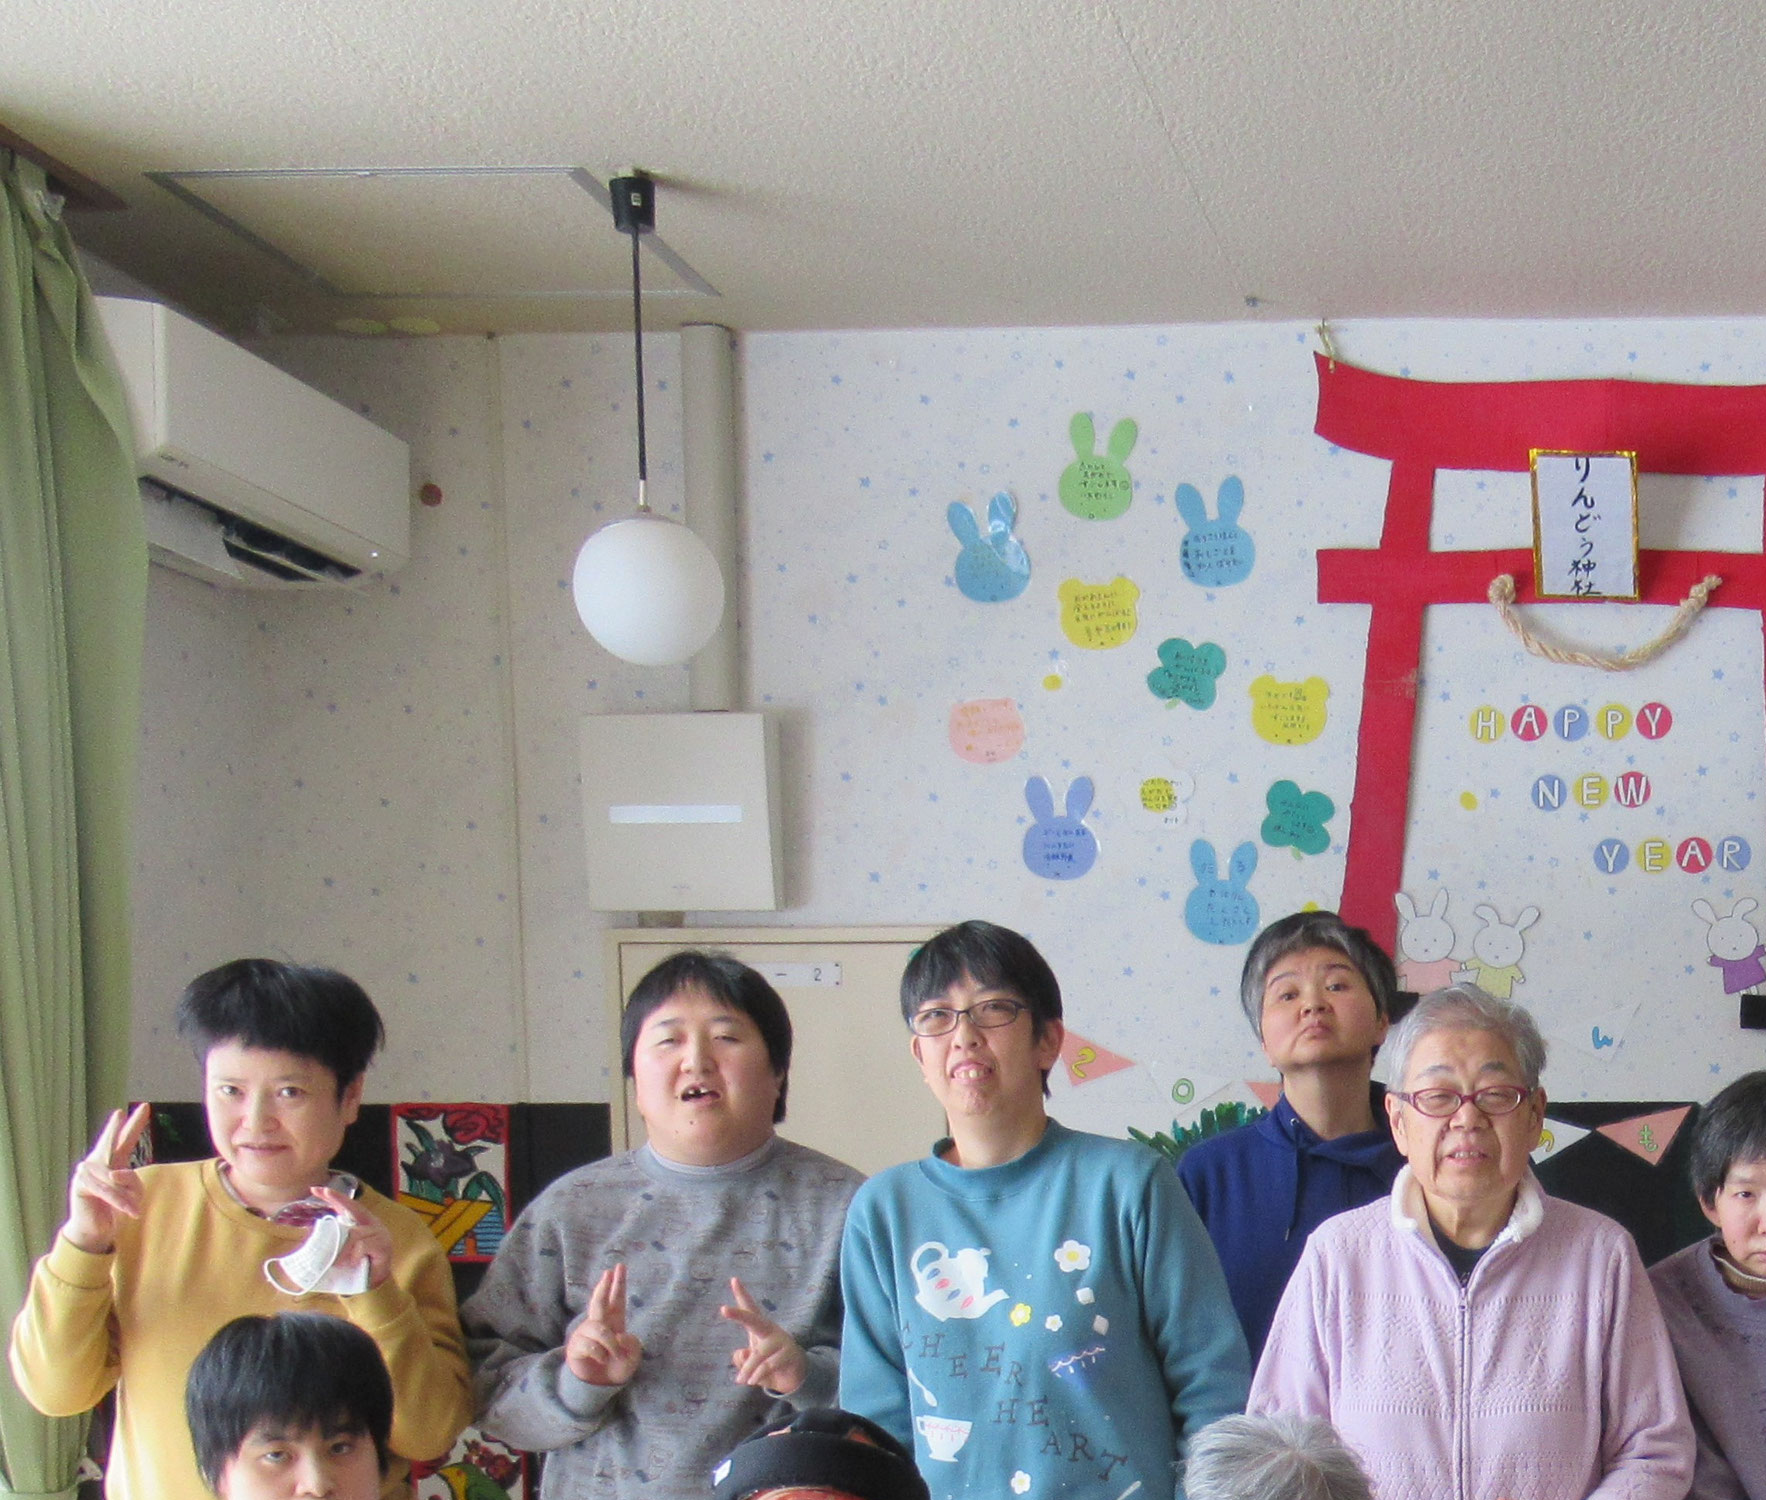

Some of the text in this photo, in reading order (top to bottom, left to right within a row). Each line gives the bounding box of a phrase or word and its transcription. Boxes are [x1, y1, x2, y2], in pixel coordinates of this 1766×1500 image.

[1568, 457, 1602, 596] りんどう神社
[1474, 705, 1662, 741] HAPPY
[1537, 775, 1650, 809] NEW
[1598, 839, 1747, 873] YEAR
[989, 1394, 1129, 1482] HEART
